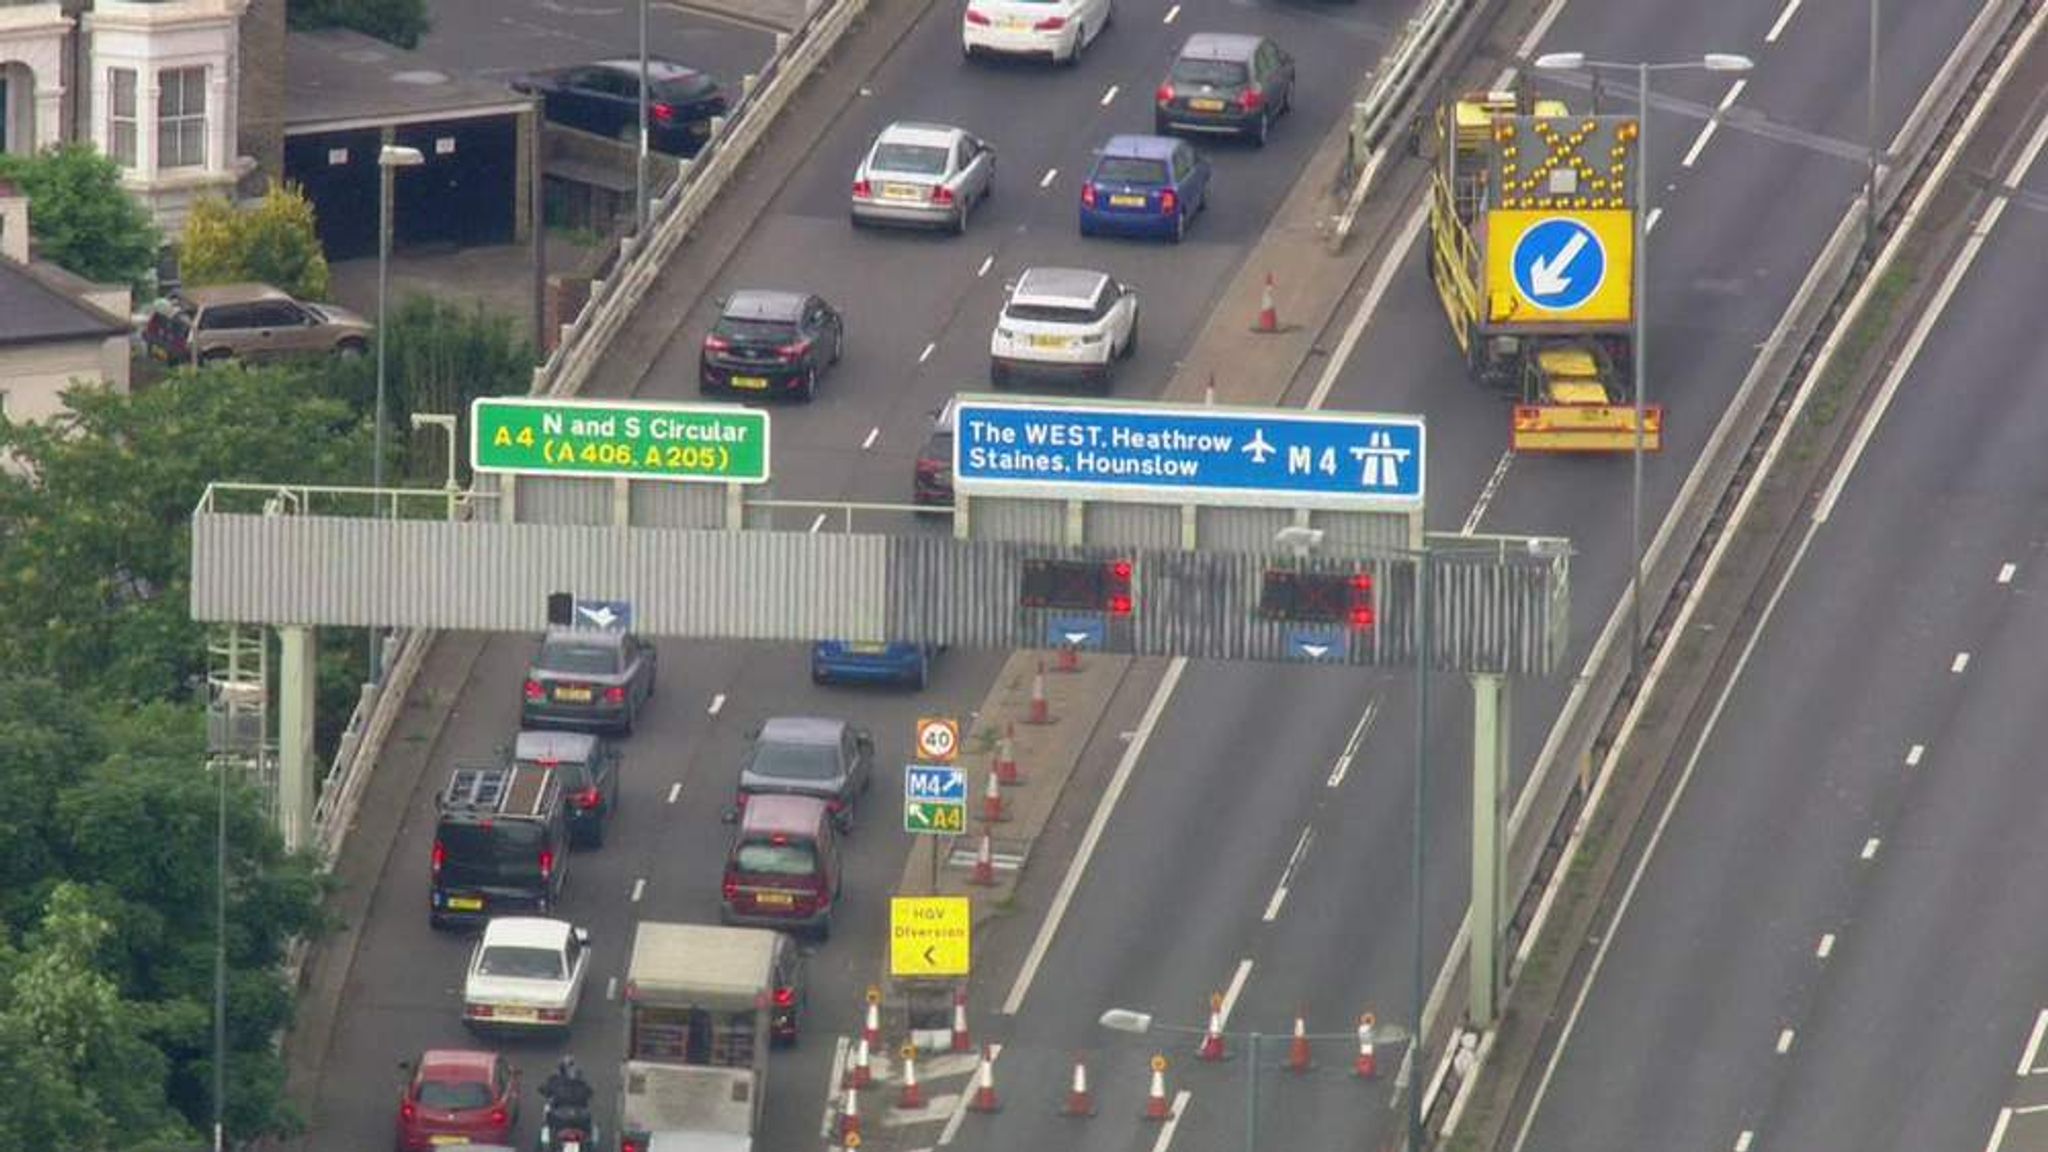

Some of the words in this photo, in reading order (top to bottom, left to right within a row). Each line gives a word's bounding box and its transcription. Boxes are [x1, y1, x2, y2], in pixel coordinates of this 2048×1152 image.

[542, 412, 563, 434] N
[570, 416, 615, 437] and
[624, 417, 641, 438] S
[650, 417, 748, 443] Circular
[969, 421, 1015, 444] The
[1112, 430, 1232, 453] Heathrow
[1076, 454, 1199, 477] Hounslow
[925, 731, 950, 748] 40
[909, 772, 940, 795] M4
[932, 808, 961, 830] A4
